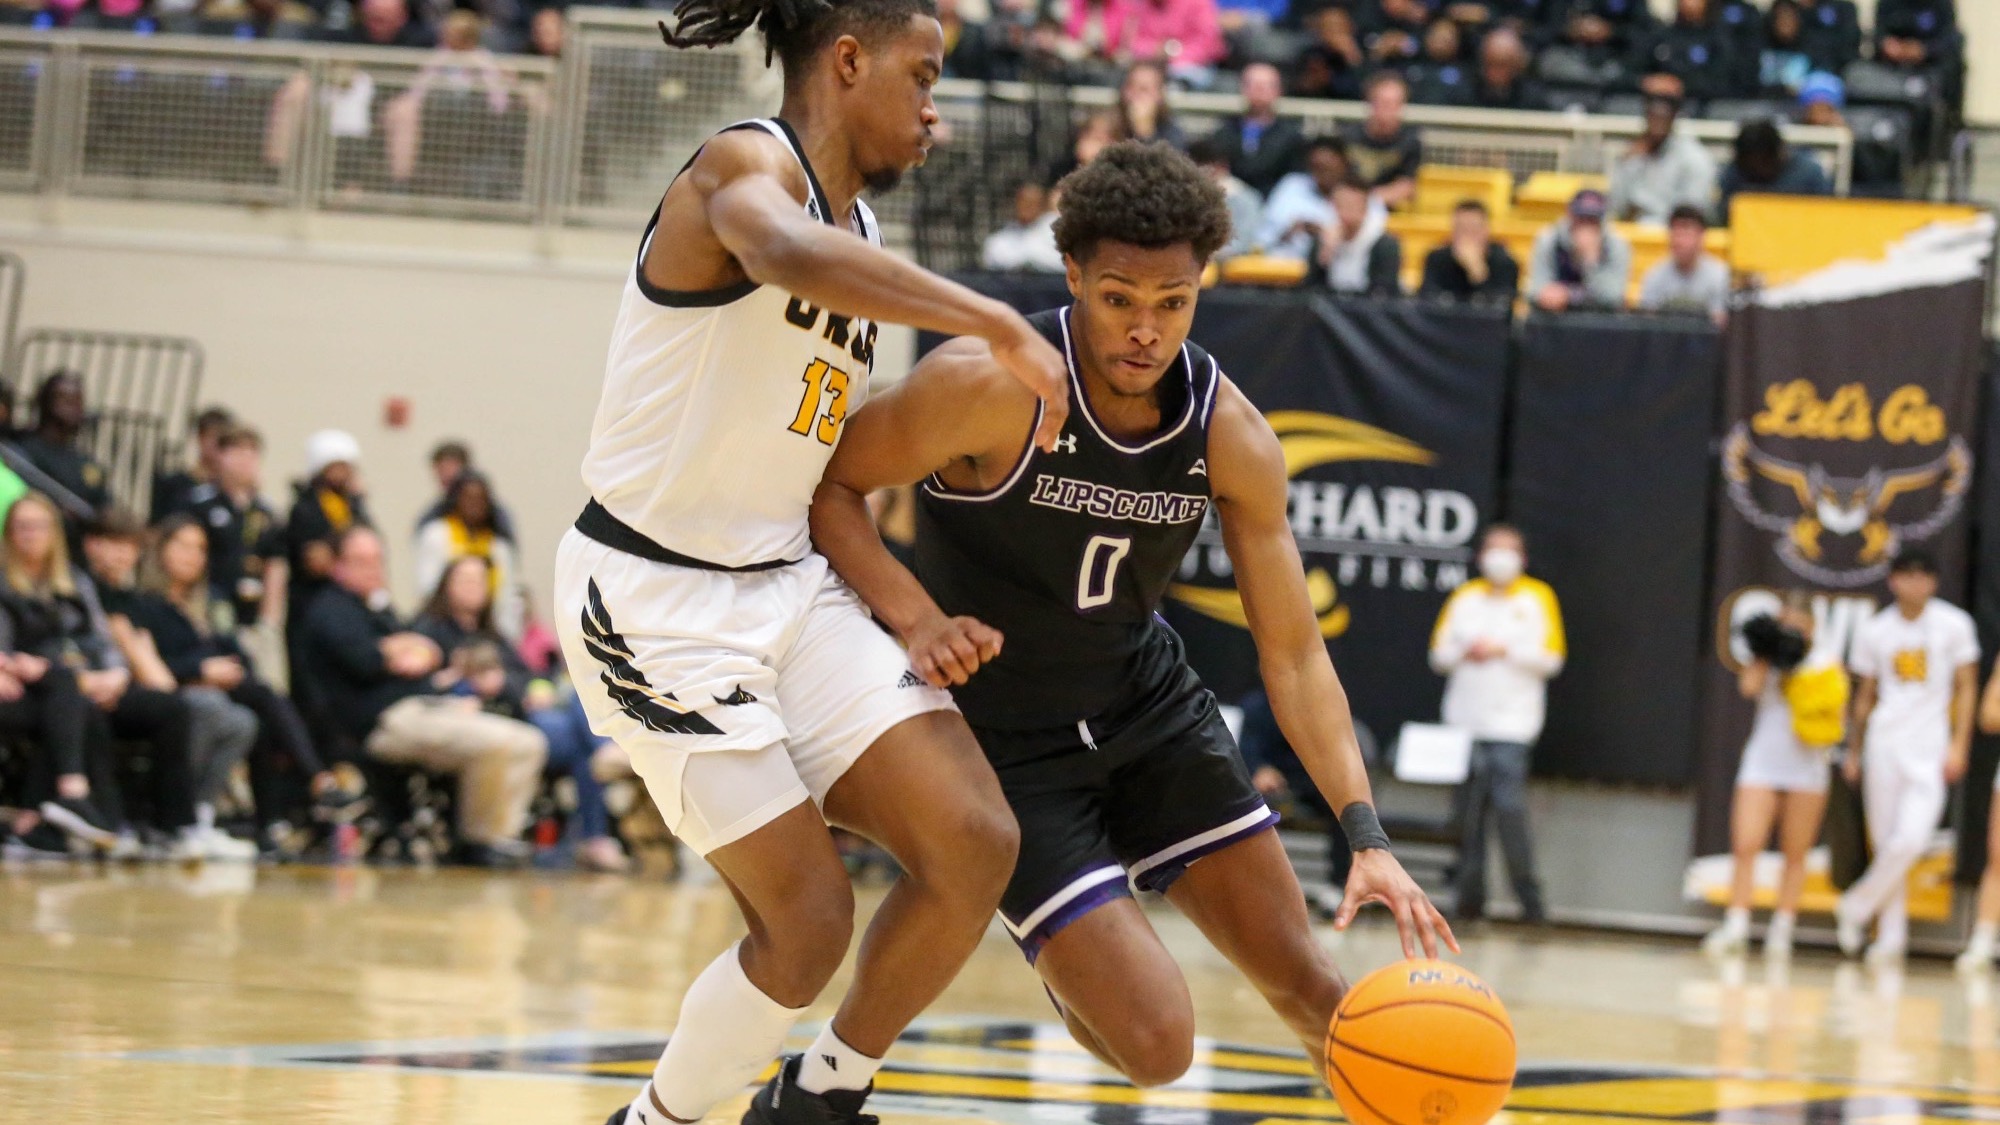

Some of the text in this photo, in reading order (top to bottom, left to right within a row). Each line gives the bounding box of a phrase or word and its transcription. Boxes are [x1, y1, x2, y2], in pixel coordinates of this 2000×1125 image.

[787, 357, 849, 446] 13
[1877, 384, 1947, 445] Go
[1029, 474, 1208, 524] LIPSCOMB
[1077, 535, 1131, 609] 0
